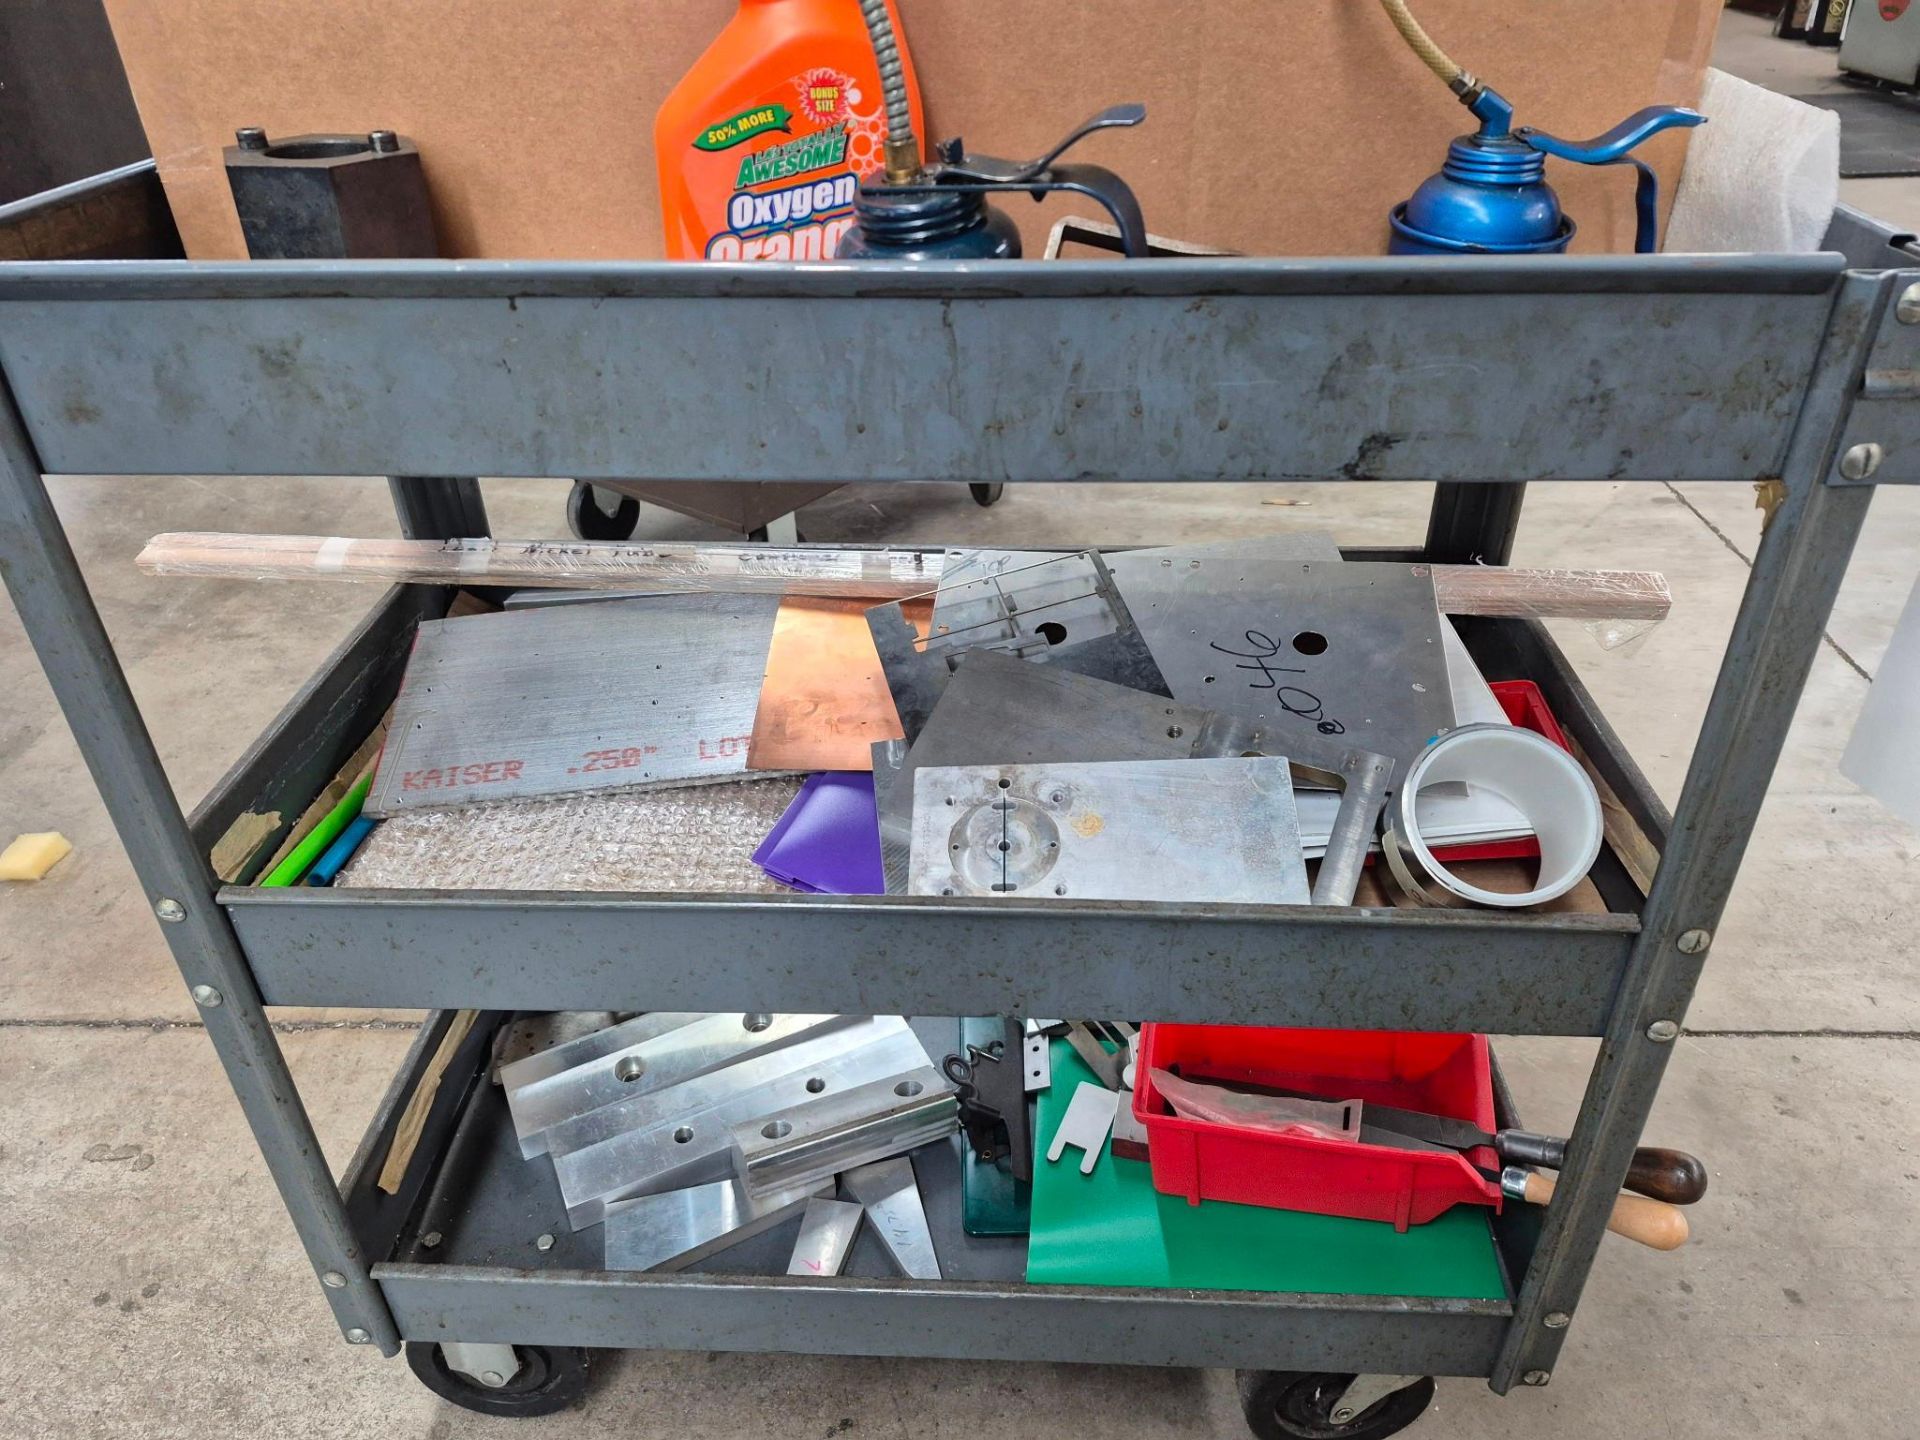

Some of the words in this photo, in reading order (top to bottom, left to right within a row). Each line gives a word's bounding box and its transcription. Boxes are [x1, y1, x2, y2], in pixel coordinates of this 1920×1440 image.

[809, 86, 839, 100] BONUS
[815, 99, 836, 113] SIZE
[707, 123, 737, 144] 50%
[737, 109, 775, 132] MORE
[736, 134, 848, 189] AWESOME
[731, 175, 856, 229] Oxygen
[709, 217, 854, 261] Orang
[402, 759, 525, 791] KAISER
